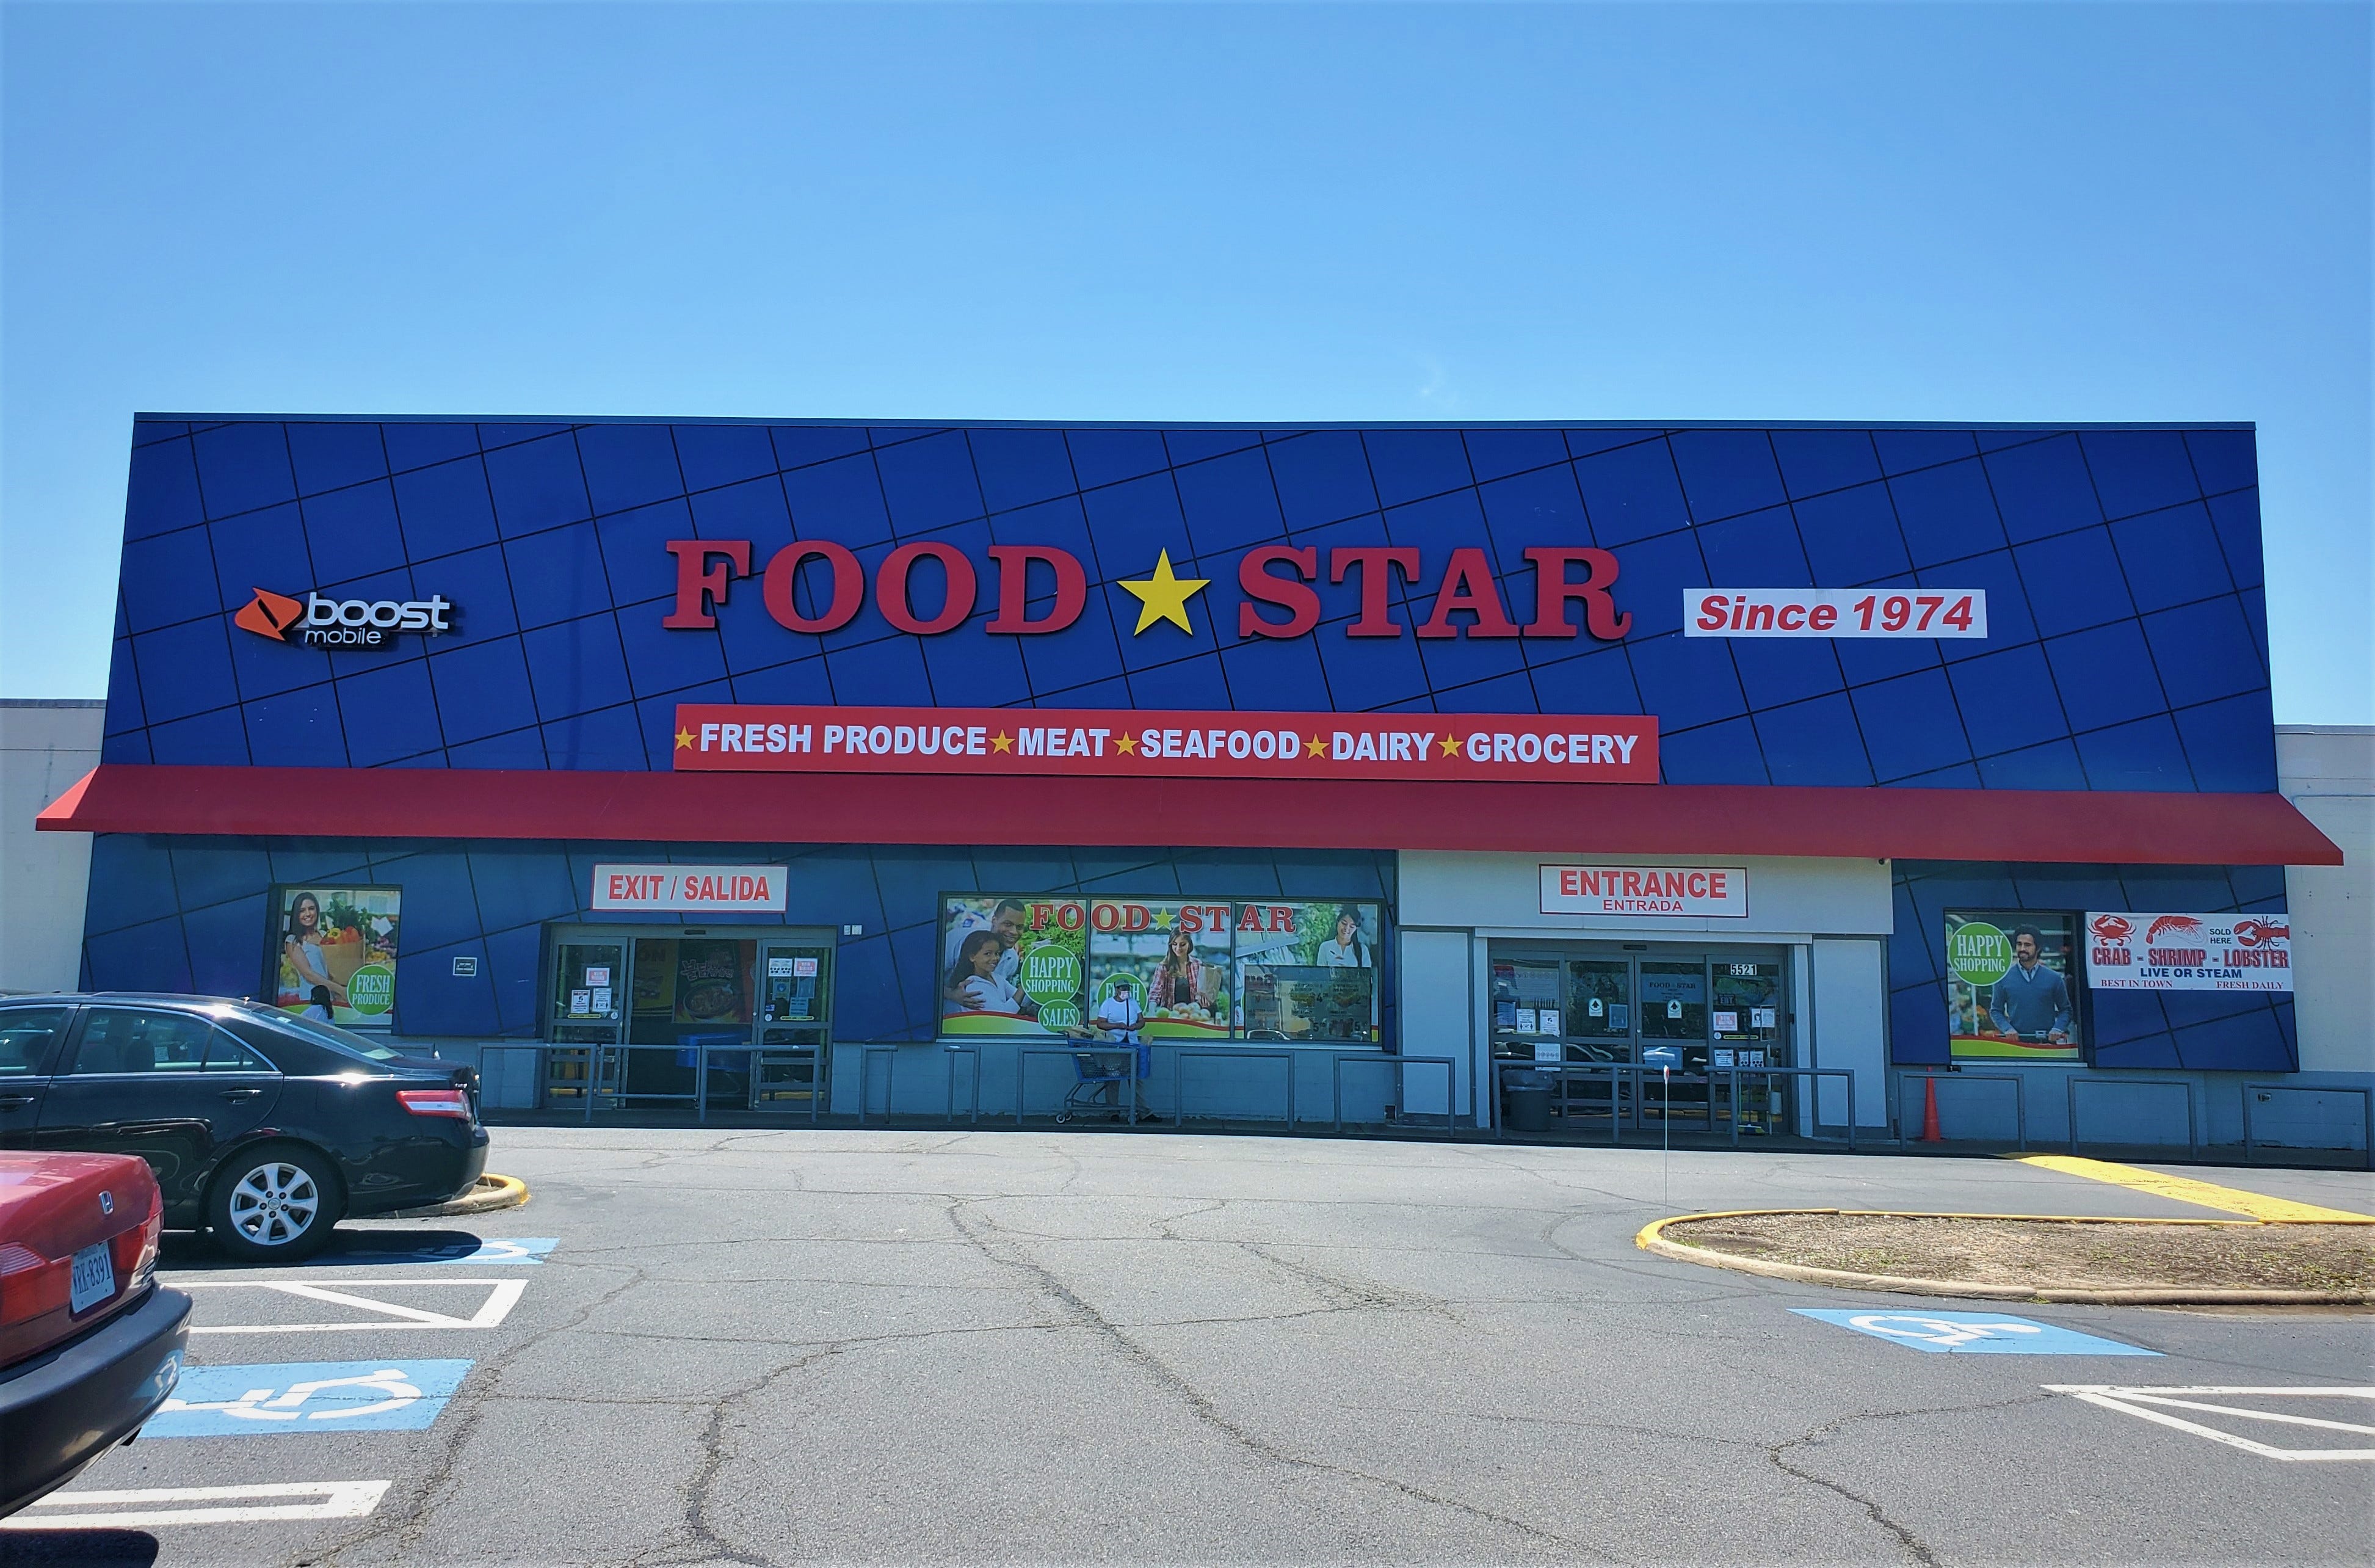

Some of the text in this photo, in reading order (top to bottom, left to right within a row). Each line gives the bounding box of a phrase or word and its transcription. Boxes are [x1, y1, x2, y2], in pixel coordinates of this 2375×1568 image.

[662, 540, 1633, 641] FOOD STAR
[308, 592, 451, 629] boost
[1695, 595, 1974, 631] Since 1974
[305, 627, 382, 645] mobile
[700, 723, 1639, 764] FRESH PRODUCE MEAT SEAFOOD DAIRY GROCERY
[609, 874, 664, 900] EXIT
[684, 875, 771, 901] SALIDA
[1559, 869, 1728, 899] ENTRANCE
[1602, 899, 1684, 912] ENTRADA
[1029, 903, 1297, 934] FOOD STAR
[2209, 927, 2232, 936] SOLD
[2209, 936, 2232, 945] HERE
[1956, 934, 2004, 957] HAPPY
[1029, 956, 1074, 978] HAPPY
[1954, 958, 2006, 973] SHOPPING
[2092, 947, 2131, 967] CRAB
[2148, 948, 2207, 967] SHRIMP
[2223, 949, 2290, 968] LOBSTER
[1730, 964, 1757, 975] 5521
[2140, 967, 2243, 979] LIVE OR STEAM
[356, 975, 390, 993] FRESH
[1025, 979, 1075, 993] SHOPPING
[352, 993, 390, 1006] PRODUCE
[1042, 1007, 1076, 1026] SALES
